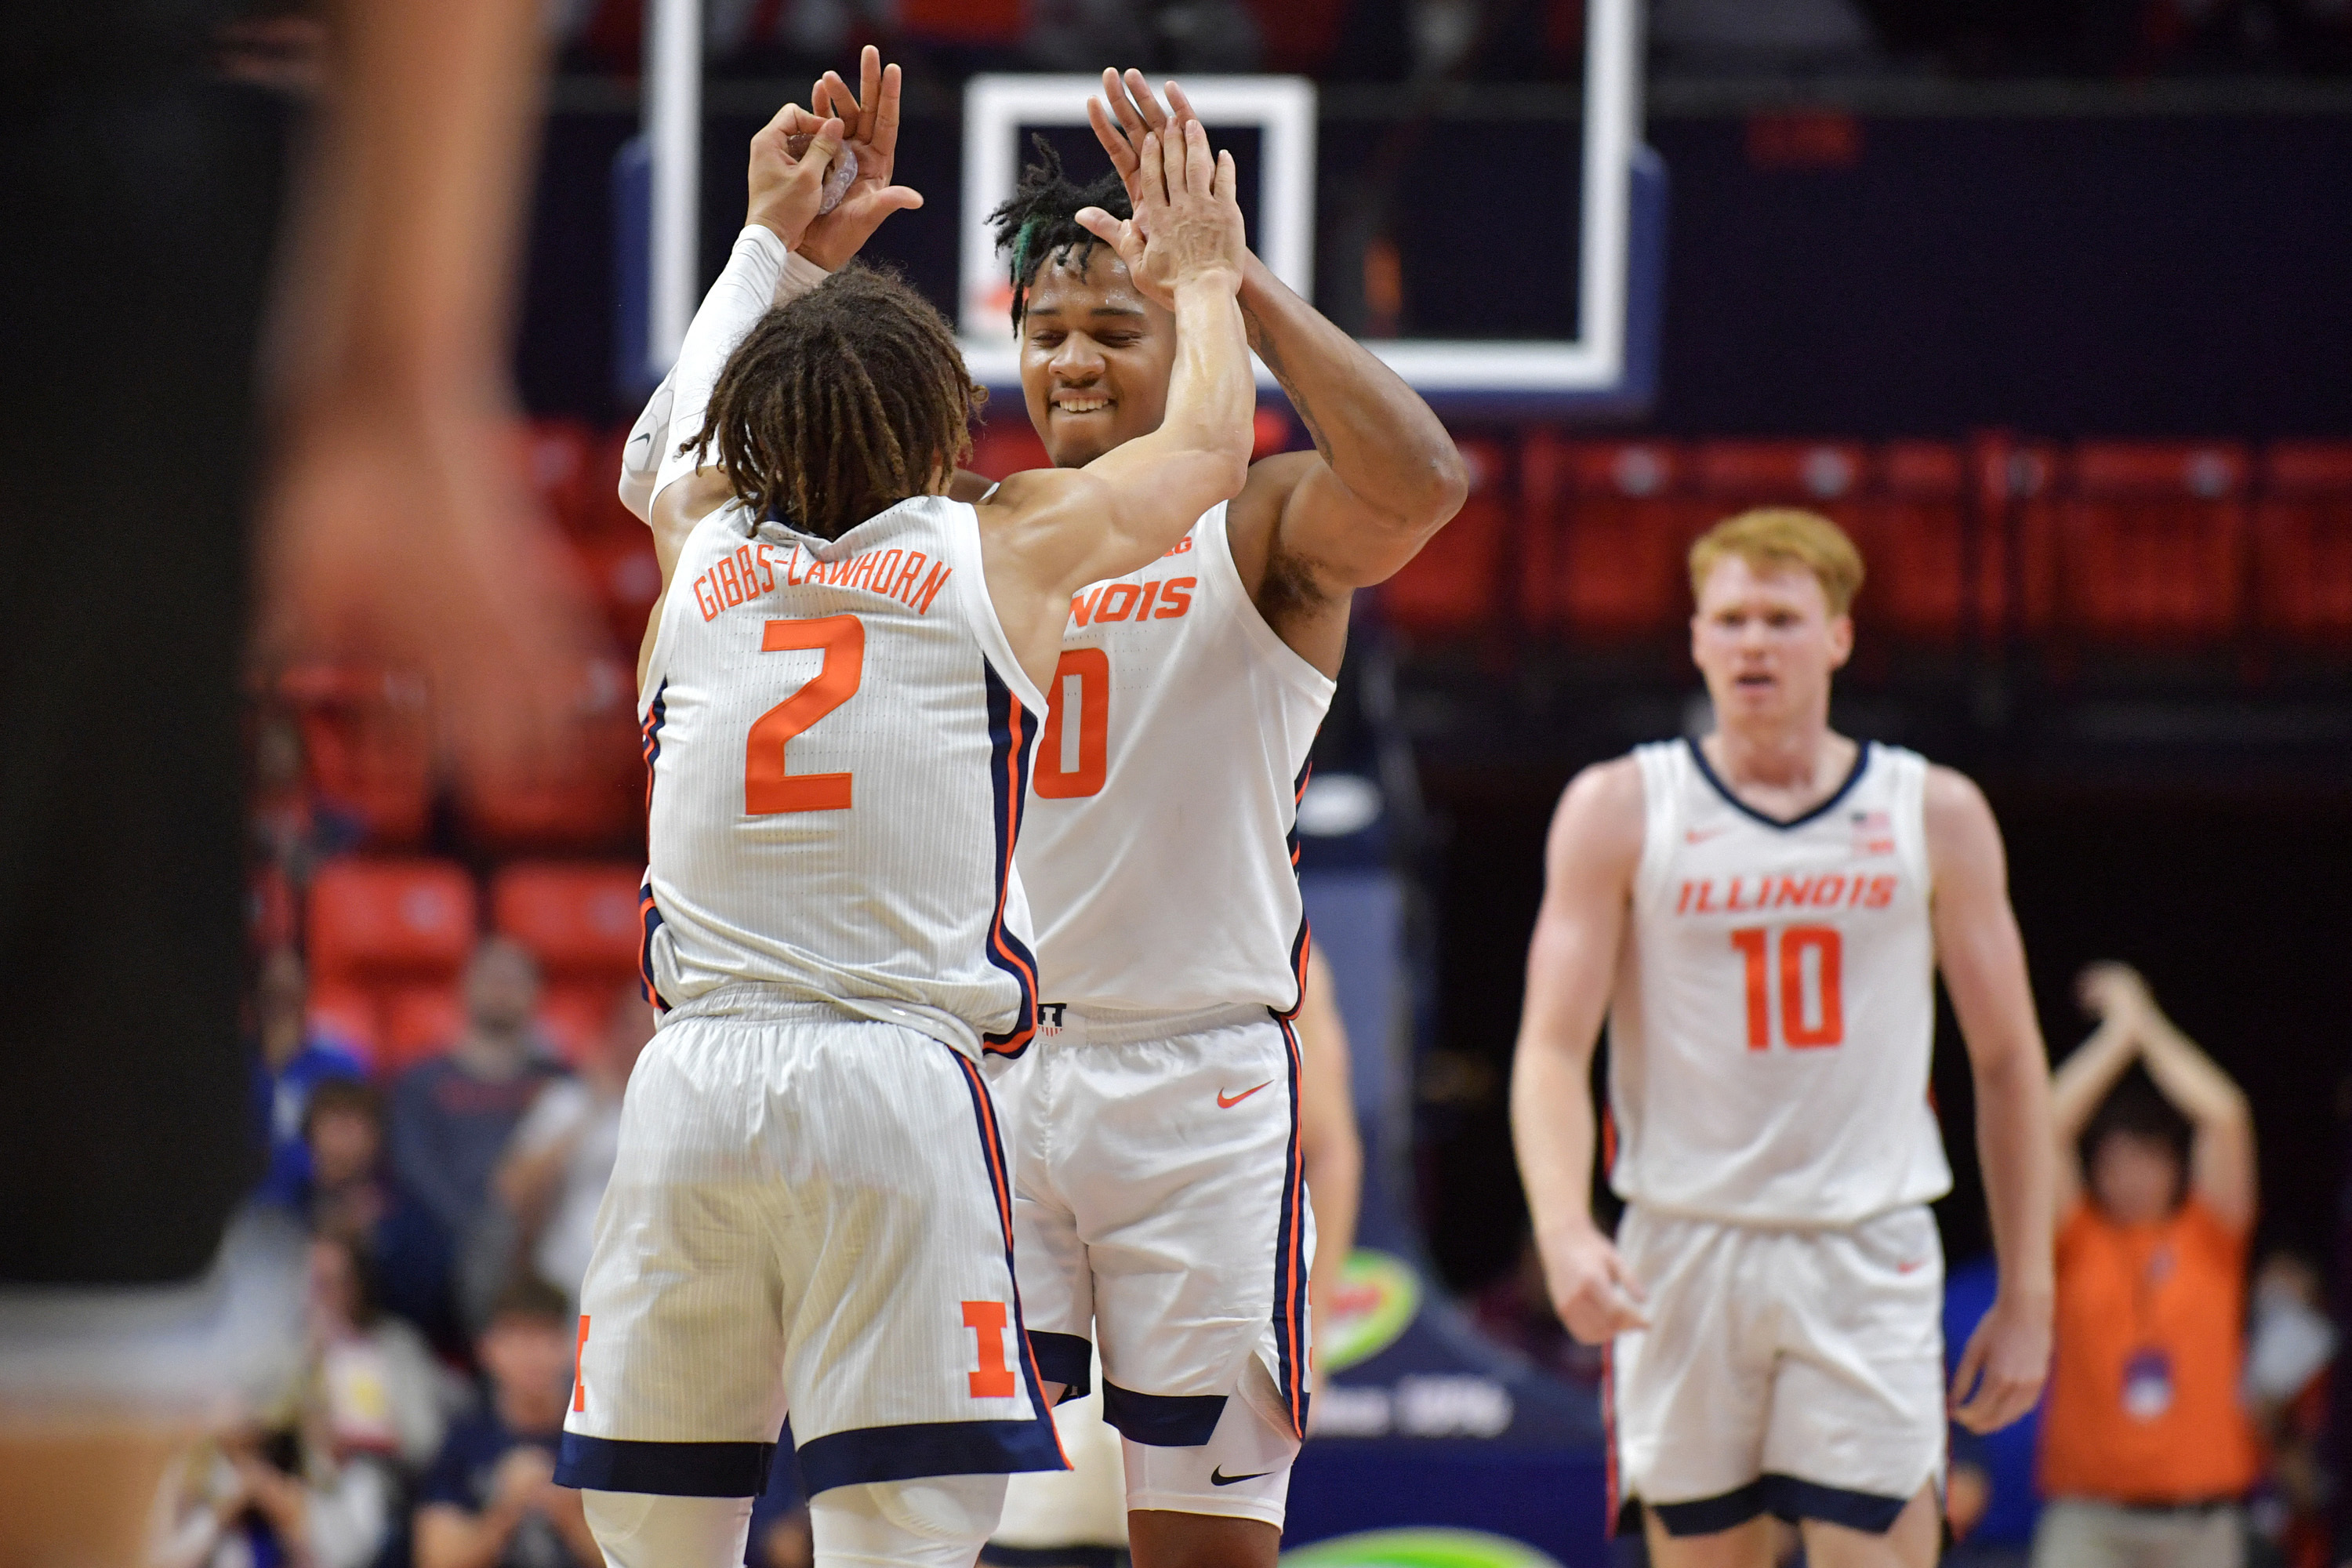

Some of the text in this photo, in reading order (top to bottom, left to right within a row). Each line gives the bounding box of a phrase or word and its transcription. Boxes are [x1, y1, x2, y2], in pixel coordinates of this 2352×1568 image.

[694, 544, 952, 622] GIBBS-LAWHORN
[745, 614, 865, 815] 2
[1033, 648, 1109, 799] 0
[1675, 873, 1897, 916] ILLINOIS
[1730, 924, 1843, 1052] 10
[961, 1301, 1015, 1399] I
